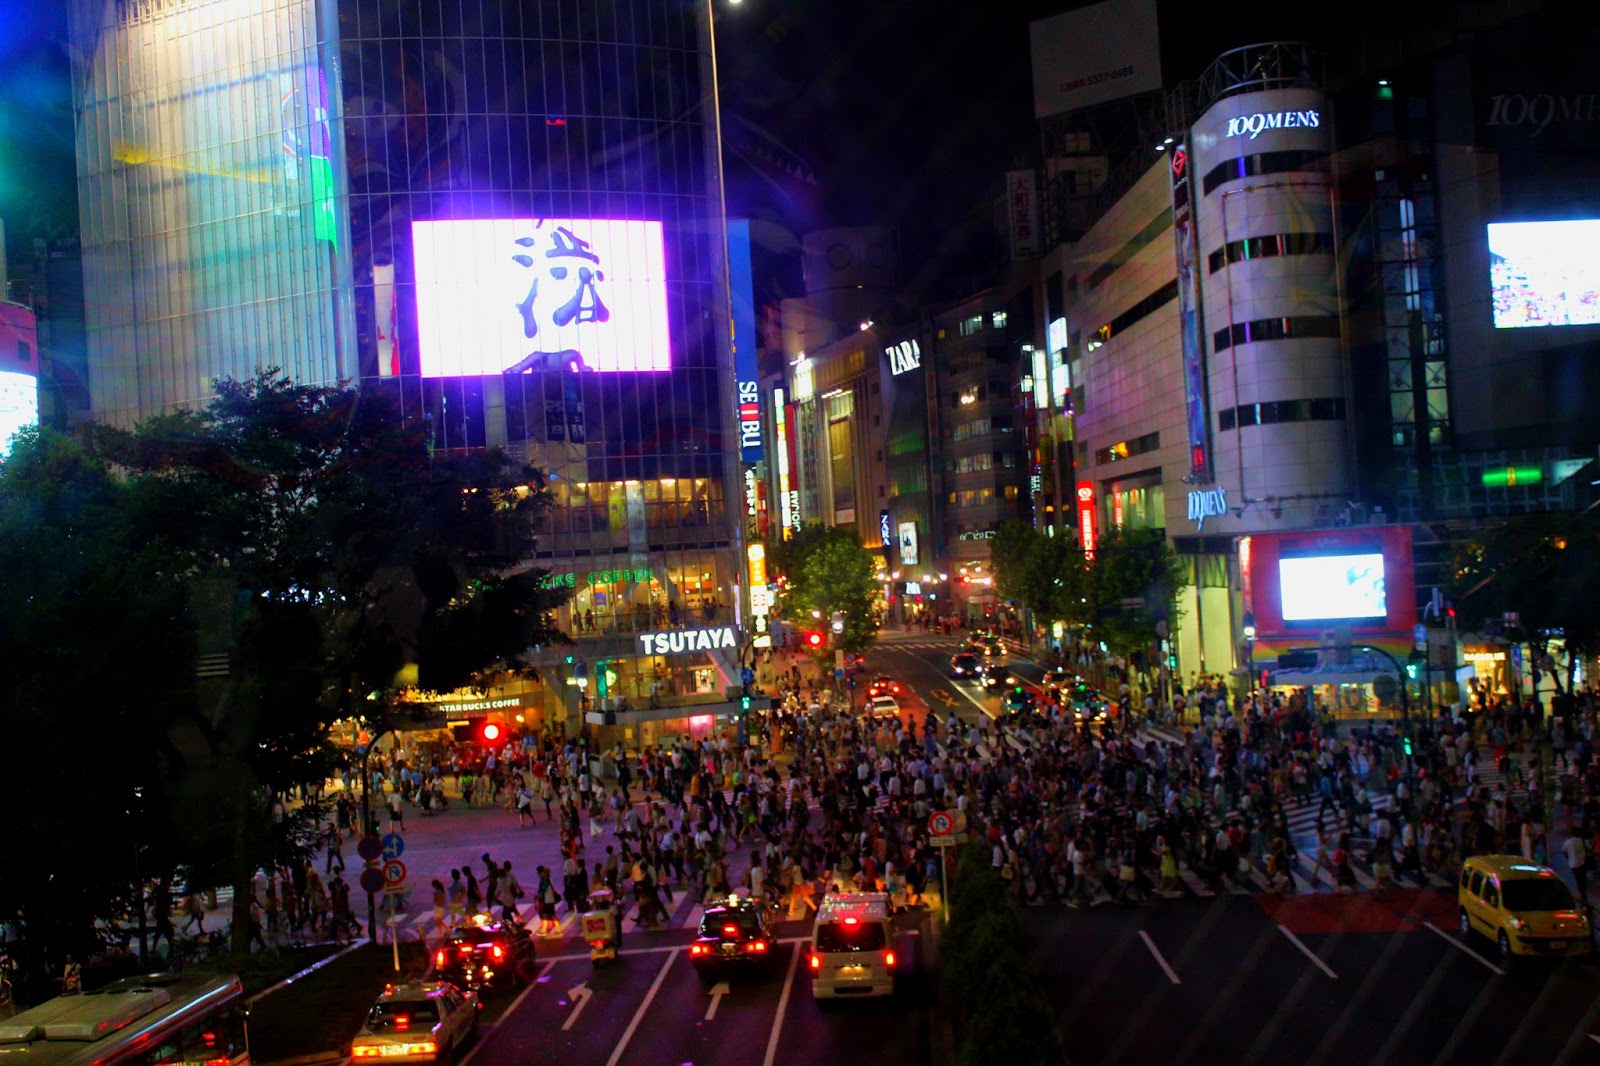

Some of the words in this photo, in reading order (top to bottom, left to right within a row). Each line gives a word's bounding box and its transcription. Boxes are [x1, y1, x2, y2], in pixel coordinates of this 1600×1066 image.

[1226, 110, 1319, 139] 109MEN'S
[885, 338, 921, 376] ZARA
[739, 381, 761, 448] SEIBU
[881, 514, 890, 546] ZARA
[587, 568, 655, 586] COFFEE
[640, 628, 736, 655] TSUTAYA
[439, 702, 491, 712] STARBUCKS
[492, 698, 520, 709] COFFEE
